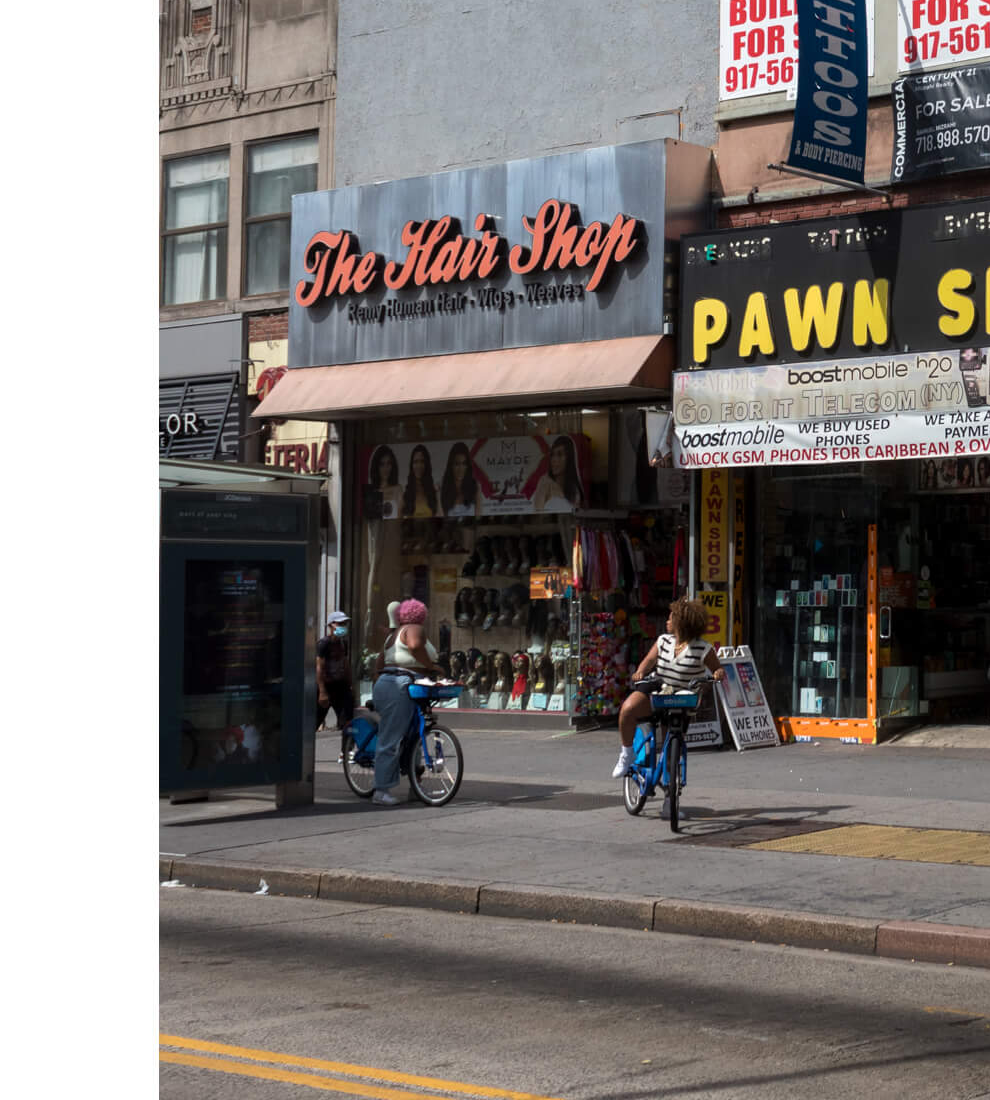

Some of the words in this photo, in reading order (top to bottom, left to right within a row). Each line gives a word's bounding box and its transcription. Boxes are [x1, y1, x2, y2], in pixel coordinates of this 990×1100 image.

[733, 25, 785, 61] FOR
[916, 69, 965, 84] CENTURY
[966, 67, 977, 77] 21
[916, 100, 946, 120] FOR
[894, 77, 908, 178] COMMERCIAL
[802, 143, 824, 161] BODY
[824, 148, 863, 172] PIERCING
[295, 230, 379, 307] The
[384, 214, 500, 290] Hair
[509, 199, 638, 291] Shop
[348, 303, 384, 326] Remy
[387, 300, 434, 320] Human
[437, 292, 466, 315] Hair
[477, 287, 514, 311] Wigs
[524, 283, 585, 305] Weaves
[693, 278, 890, 363] PAWN
[788, 361, 908, 386] boostmobile
[720, 401, 764, 422] FOR
[772, 398, 794, 419] IT
[802, 389, 916, 417] TELECOM
[920, 381, 963, 407] (NY)
[798, 423, 819, 434] WE
[823, 422, 849, 433] BUY
[855, 419, 890, 432] USED
[924, 414, 945, 426] WE
[948, 411, 981, 423] TAKE
[682, 425, 785, 448] boostmobile
[816, 433, 870, 447] PHONES
[680, 451, 728, 466] UNLOCK
[732, 450, 764, 463] GSM
[770, 447, 828, 462] PHONES
[832, 446, 860, 460] FOR
[865, 441, 949, 459] CARIBBEAN
[954, 440, 966, 454] &
[706, 471, 723, 524] PAWN
[707, 527, 721, 579] SHOP
[734, 716, 751, 730] WE
[753, 715, 769, 728] FIX
[739, 732, 749, 742] ALL
[751, 729, 775, 741] PHONES
